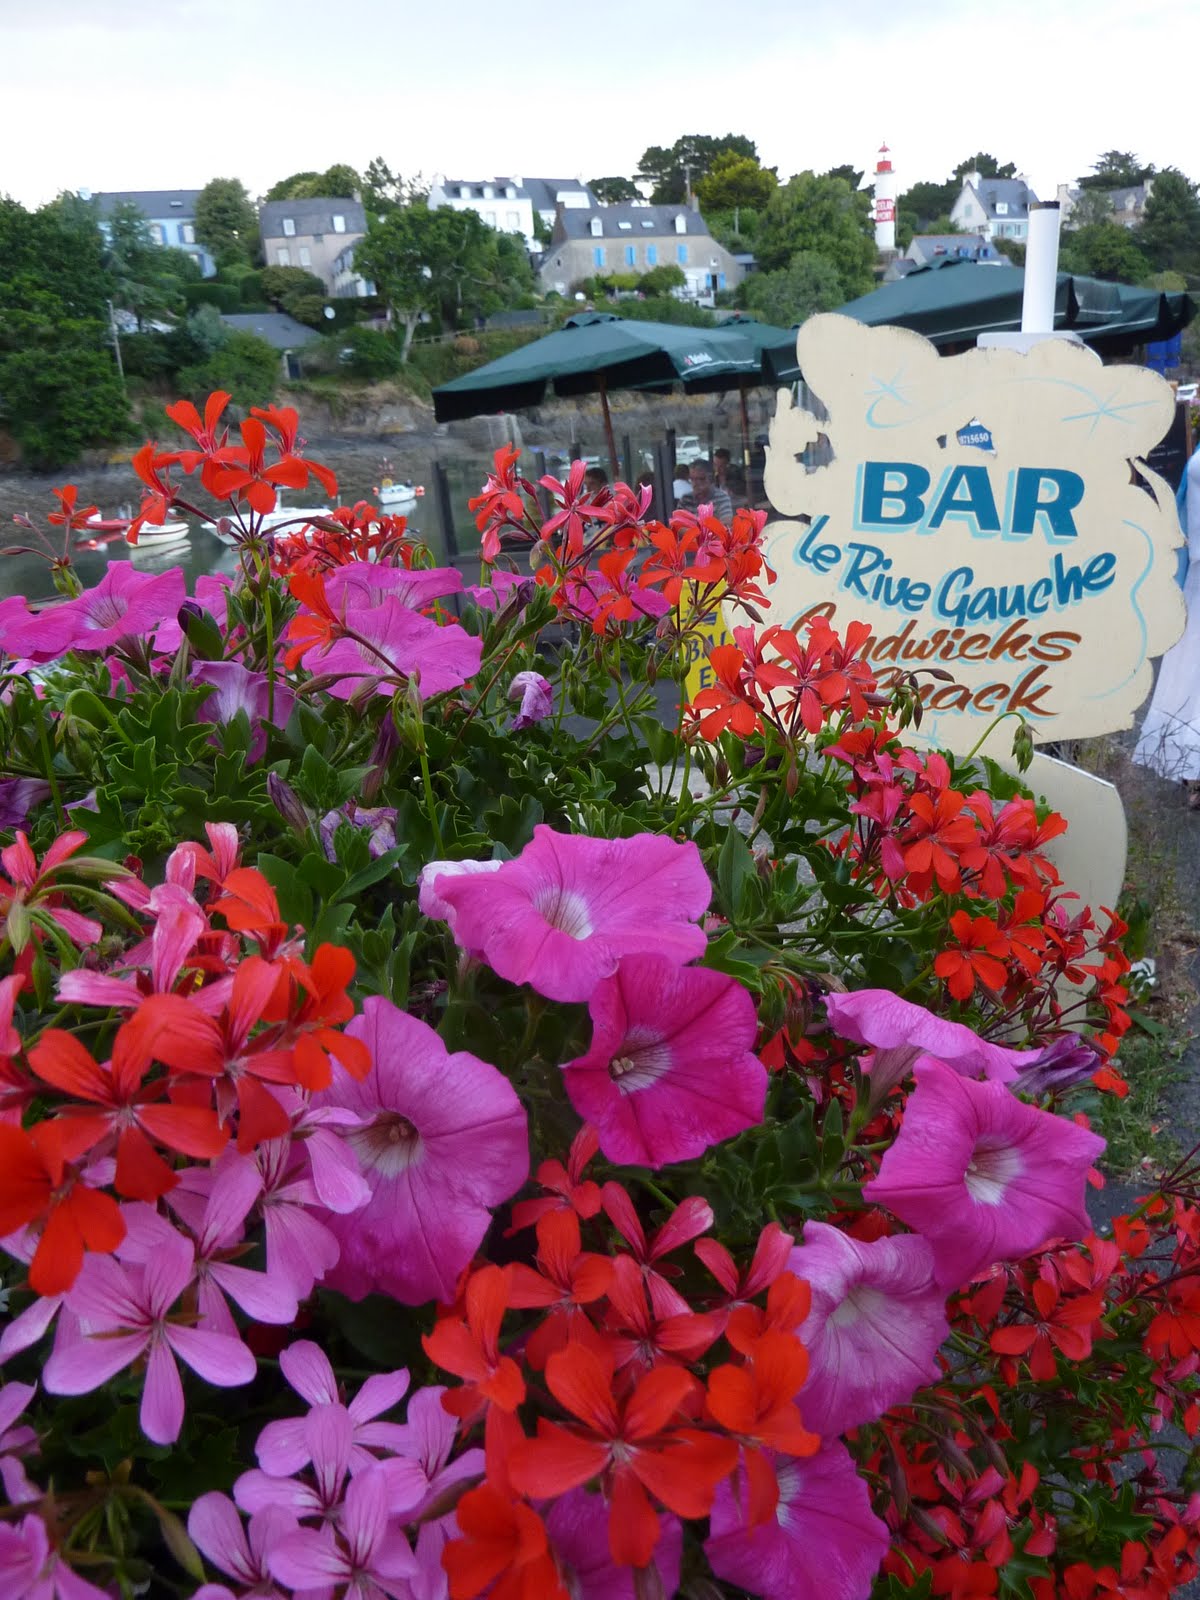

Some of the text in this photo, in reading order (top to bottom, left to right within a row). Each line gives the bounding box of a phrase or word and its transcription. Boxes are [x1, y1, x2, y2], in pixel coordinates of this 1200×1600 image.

[857, 461, 1086, 540] BAR
[843, 542, 932, 612] Rive
[937, 552, 1117, 627] Gauche
